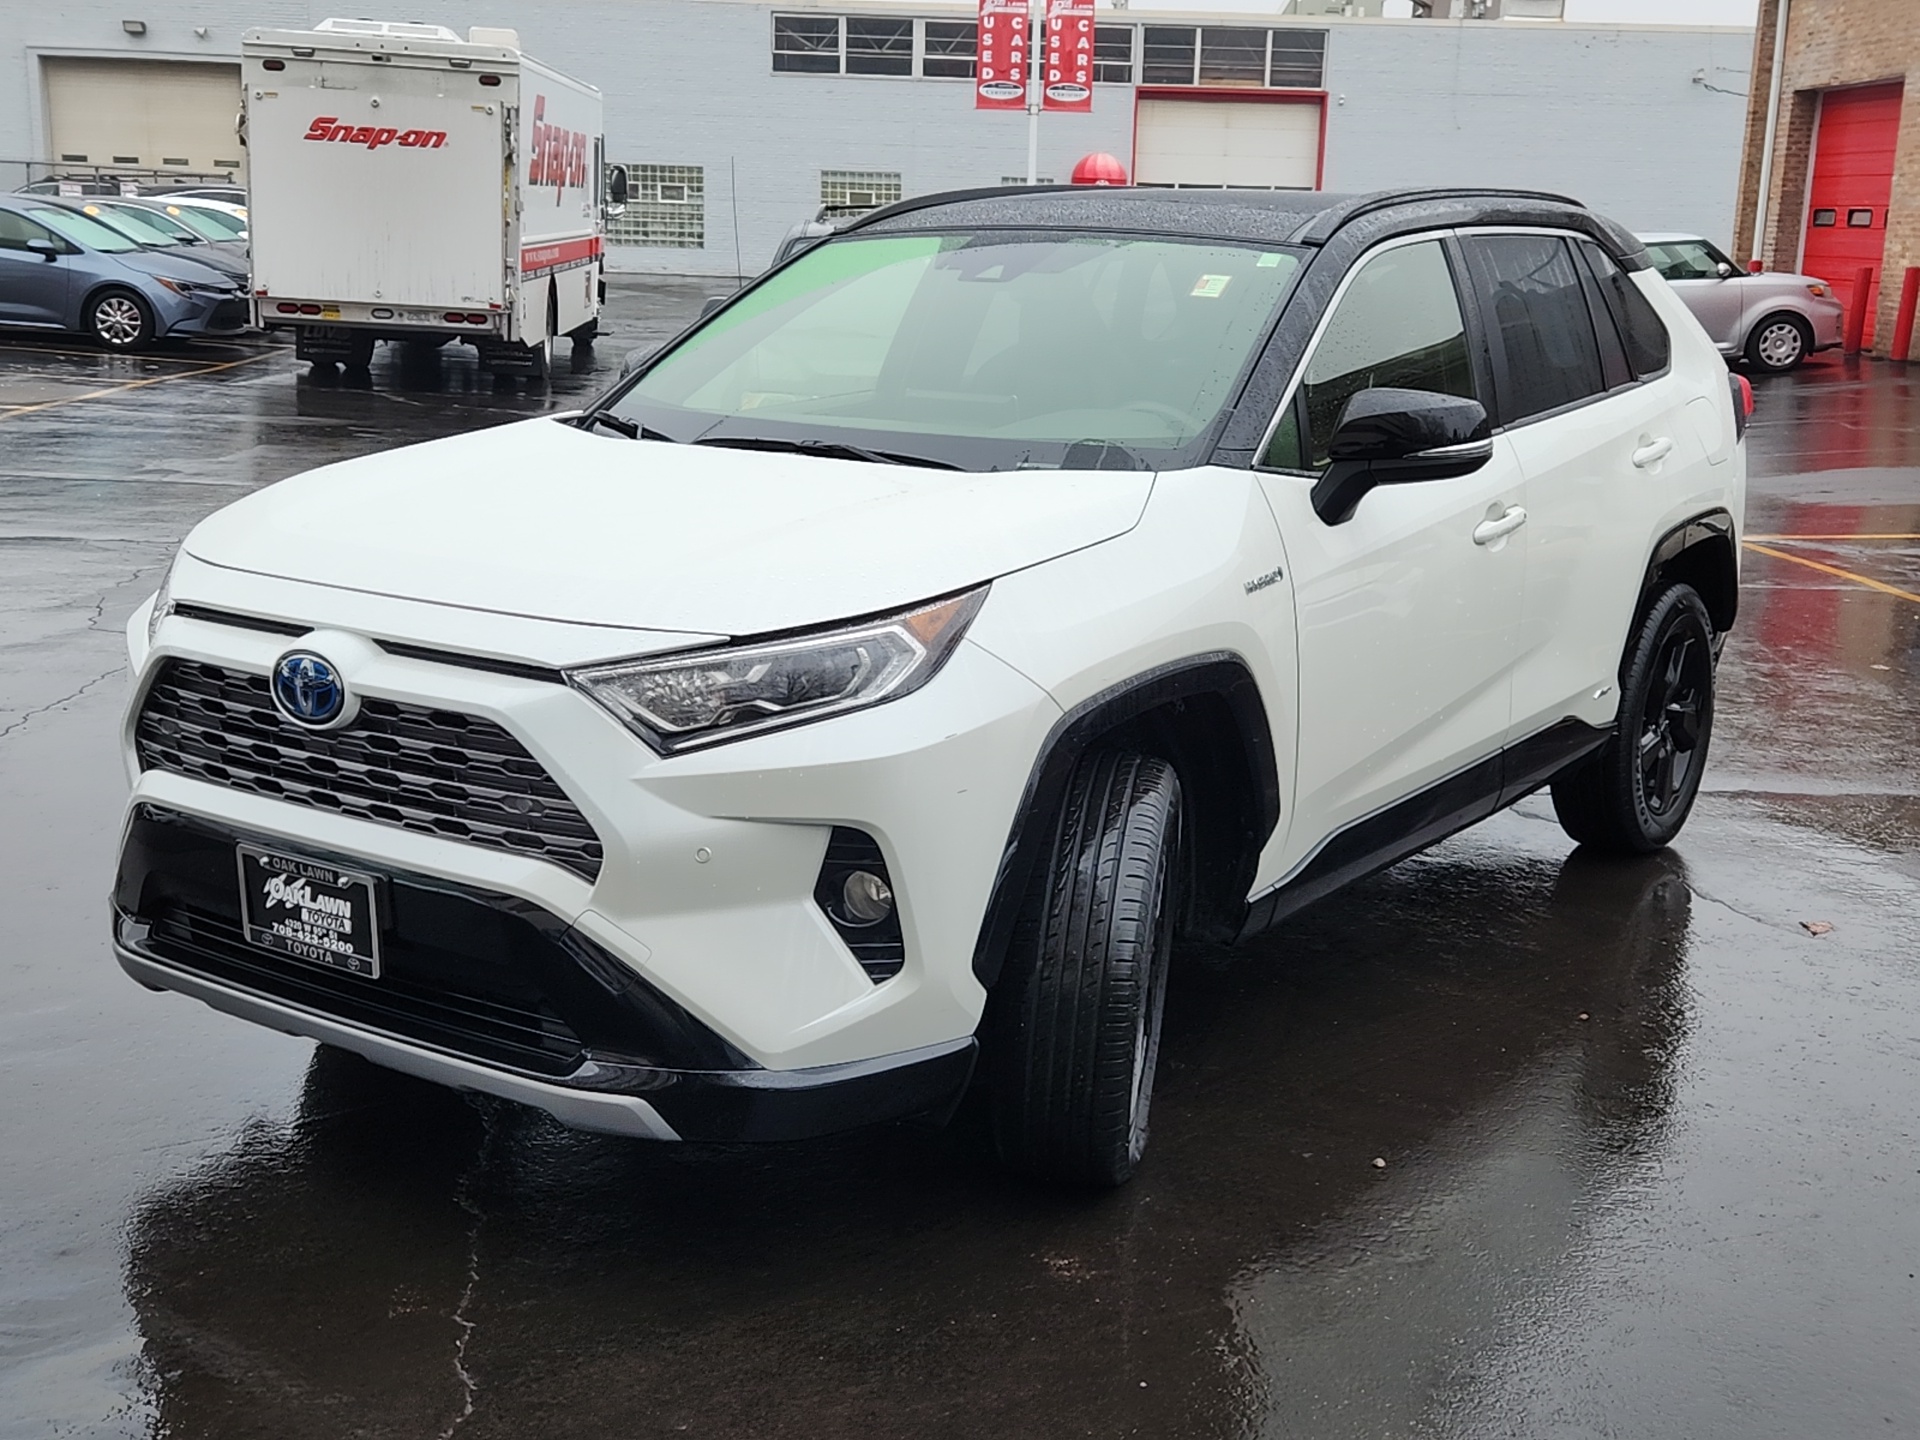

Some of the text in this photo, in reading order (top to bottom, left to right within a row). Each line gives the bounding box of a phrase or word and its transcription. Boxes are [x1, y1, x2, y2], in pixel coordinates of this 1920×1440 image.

[982, 16, 995, 80] USED
[1010, 17, 1023, 80] CARS
[1049, 19, 1062, 82] USED
[1076, 20, 1090, 83] CARS
[303, 117, 447, 150] Snap-on
[528, 94, 587, 207] Snap-on
[272, 857, 334, 882] OAK LAWN
[285, 939, 334, 964] TOYOTA
[305, 911, 346, 930] TOYOTA
